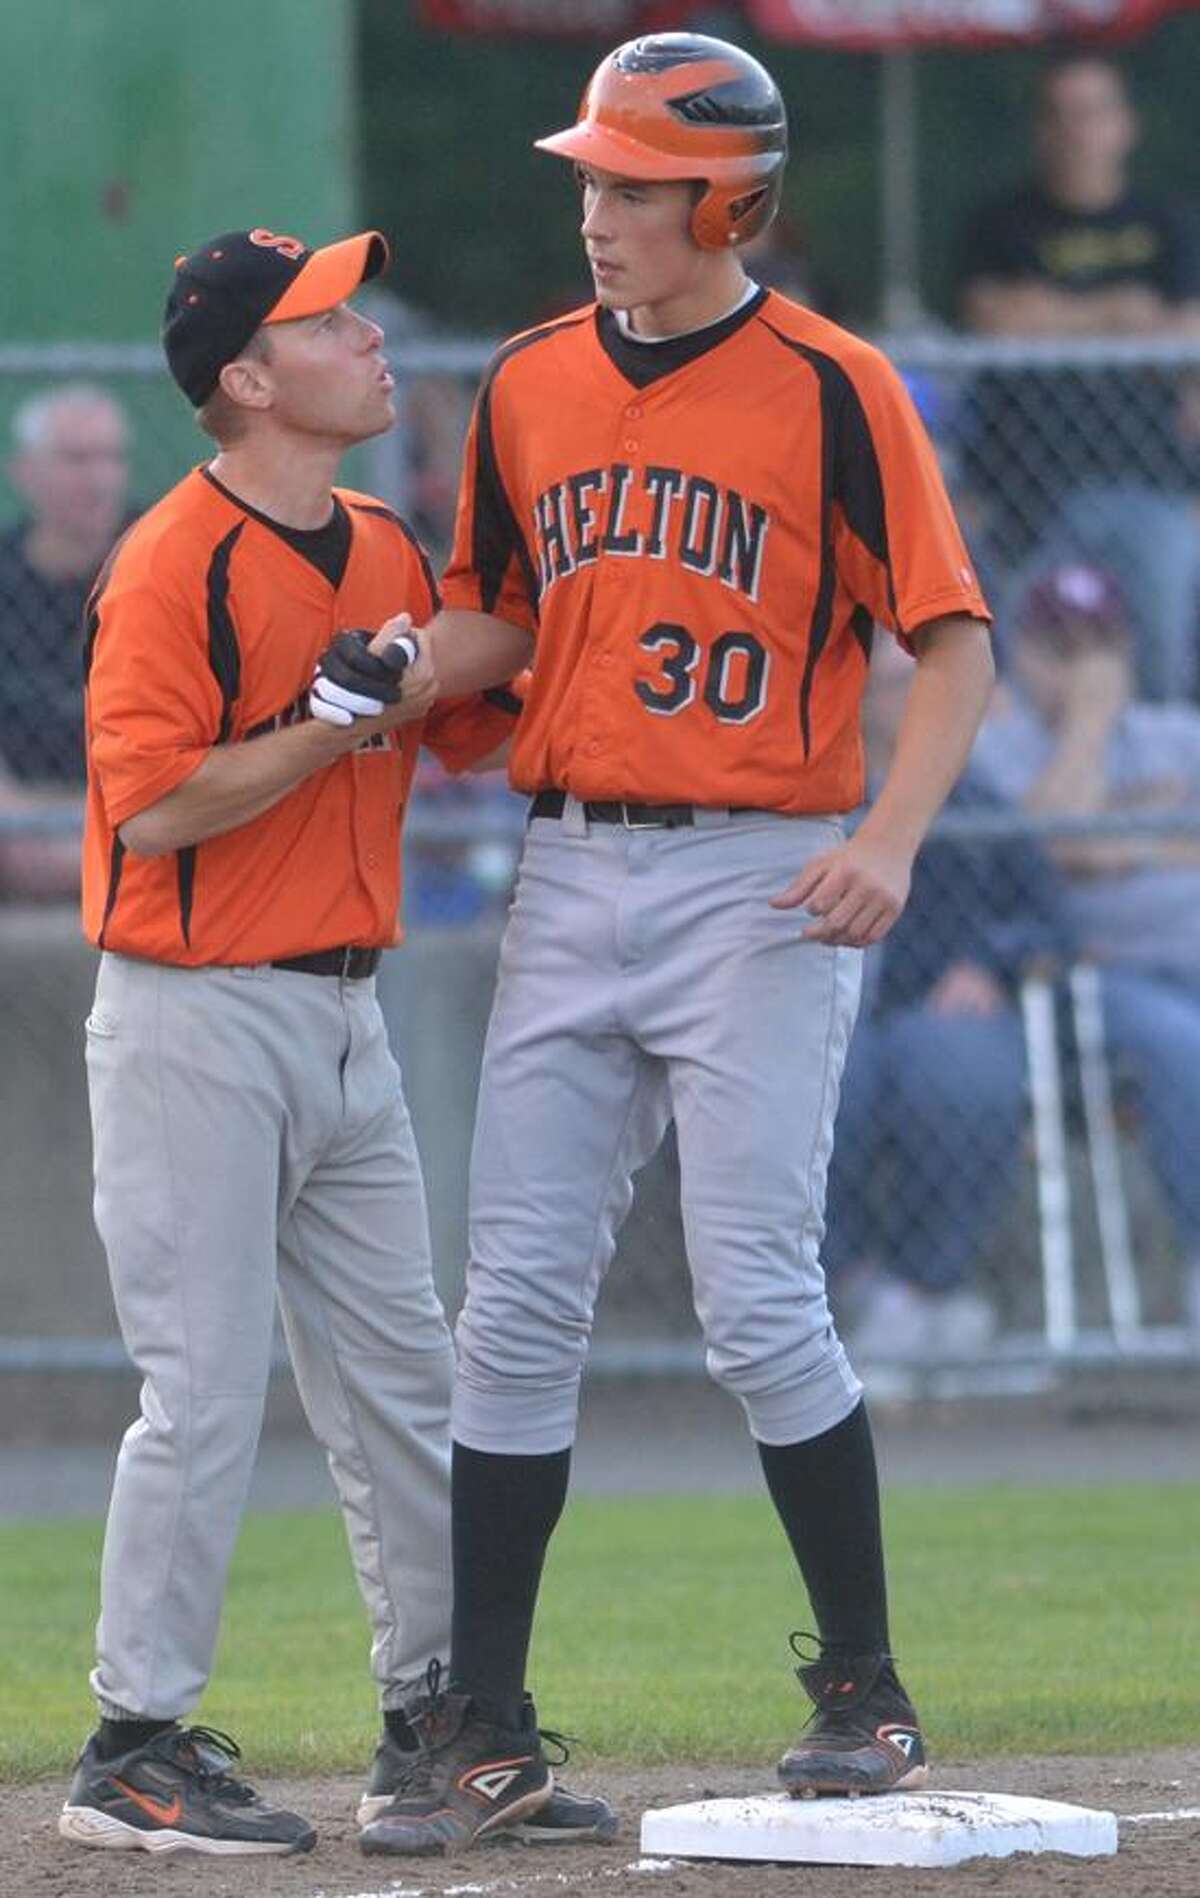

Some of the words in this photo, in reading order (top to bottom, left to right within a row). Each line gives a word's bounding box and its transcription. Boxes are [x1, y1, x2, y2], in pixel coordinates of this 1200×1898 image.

[250, 229, 304, 261] S
[534, 463, 769, 603] HELTON
[633, 621, 770, 725] 30
